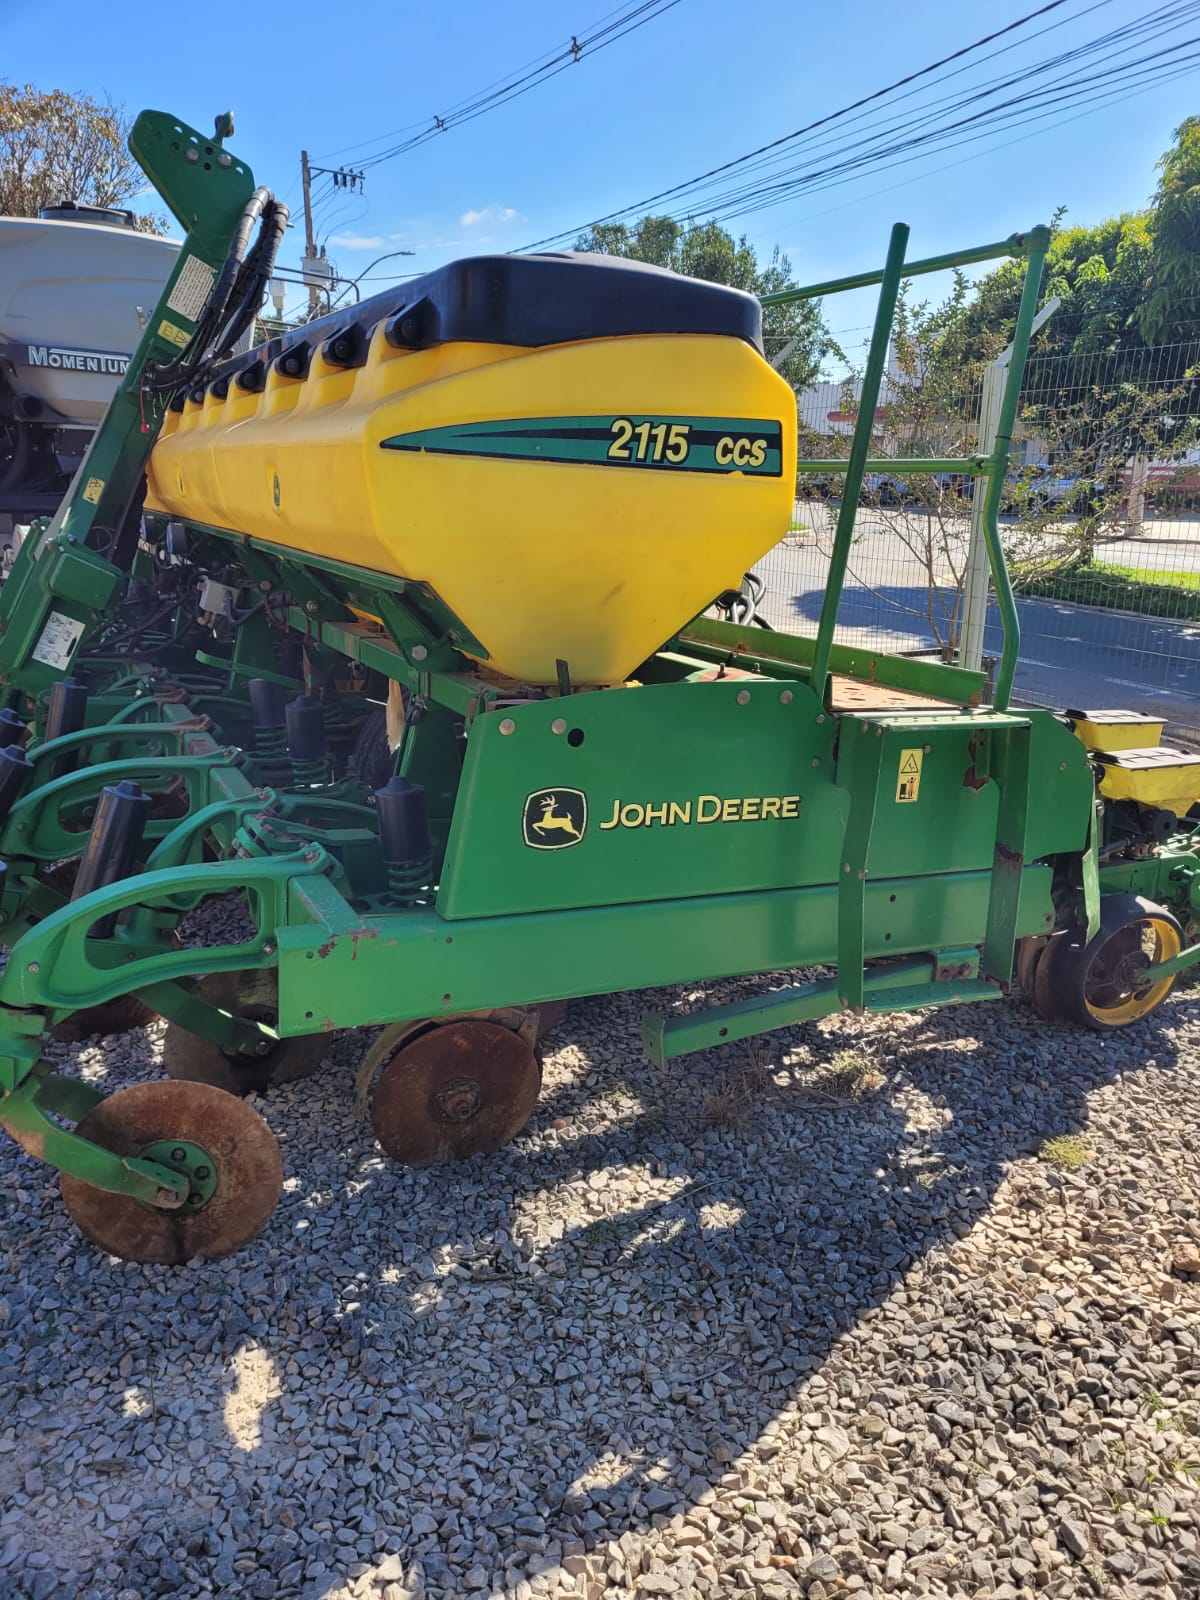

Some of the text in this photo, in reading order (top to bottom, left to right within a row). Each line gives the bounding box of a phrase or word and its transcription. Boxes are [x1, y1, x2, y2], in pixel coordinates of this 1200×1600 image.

[607, 418, 768, 467] 2115 CCS
[599, 795, 800, 829] JOHN DEERE
